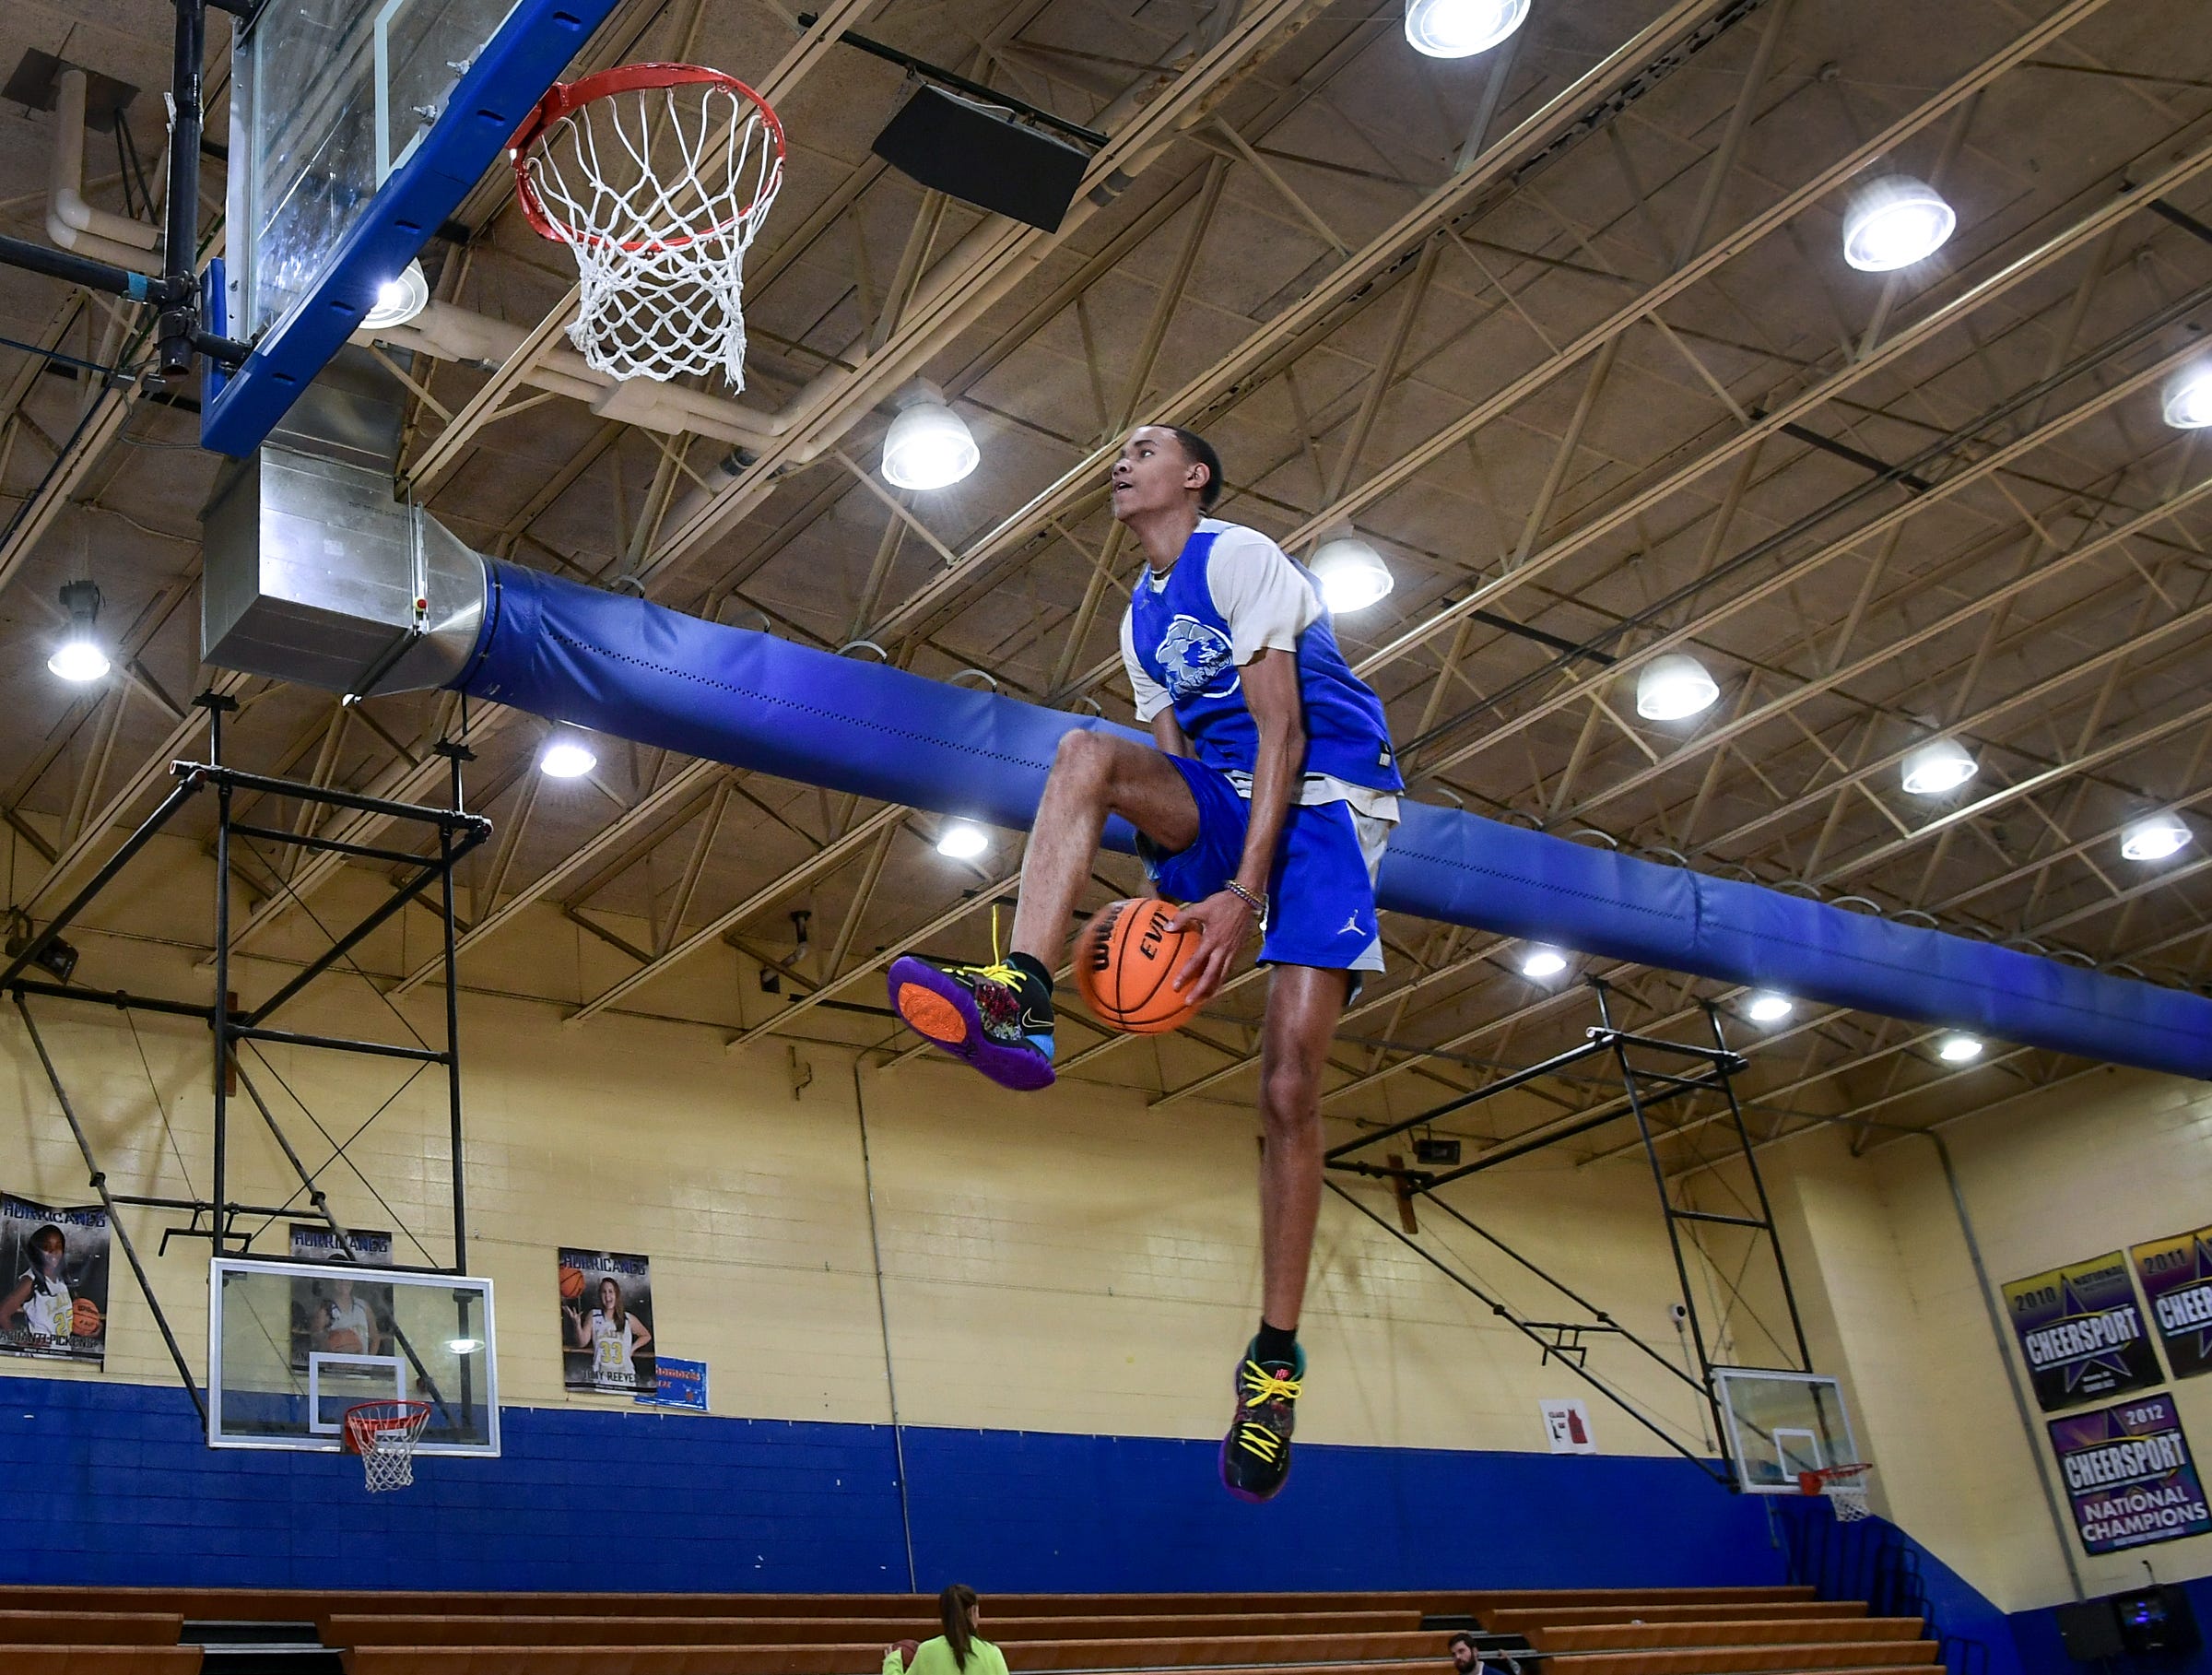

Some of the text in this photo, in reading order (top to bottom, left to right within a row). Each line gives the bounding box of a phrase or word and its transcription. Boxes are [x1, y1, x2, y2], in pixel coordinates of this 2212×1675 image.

[4, 1201, 106, 1227] HURRICANES
[295, 1232, 388, 1253] HURRIANES
[563, 1255, 646, 1276] HURRICANES
[2144, 1248, 2186, 1274] 2011
[2015, 1287, 2056, 1312] 2010
[2026, 1307, 2140, 1364] CHEERSPORT
[599, 1341, 623, 1364] 33
[2125, 1405, 2165, 1425] 2012
[2065, 1433, 2185, 1488] CHEERSPORT
[2084, 1486, 2189, 1522] NATIONAL
[2082, 1502, 2207, 1541] CHAMPIONS
